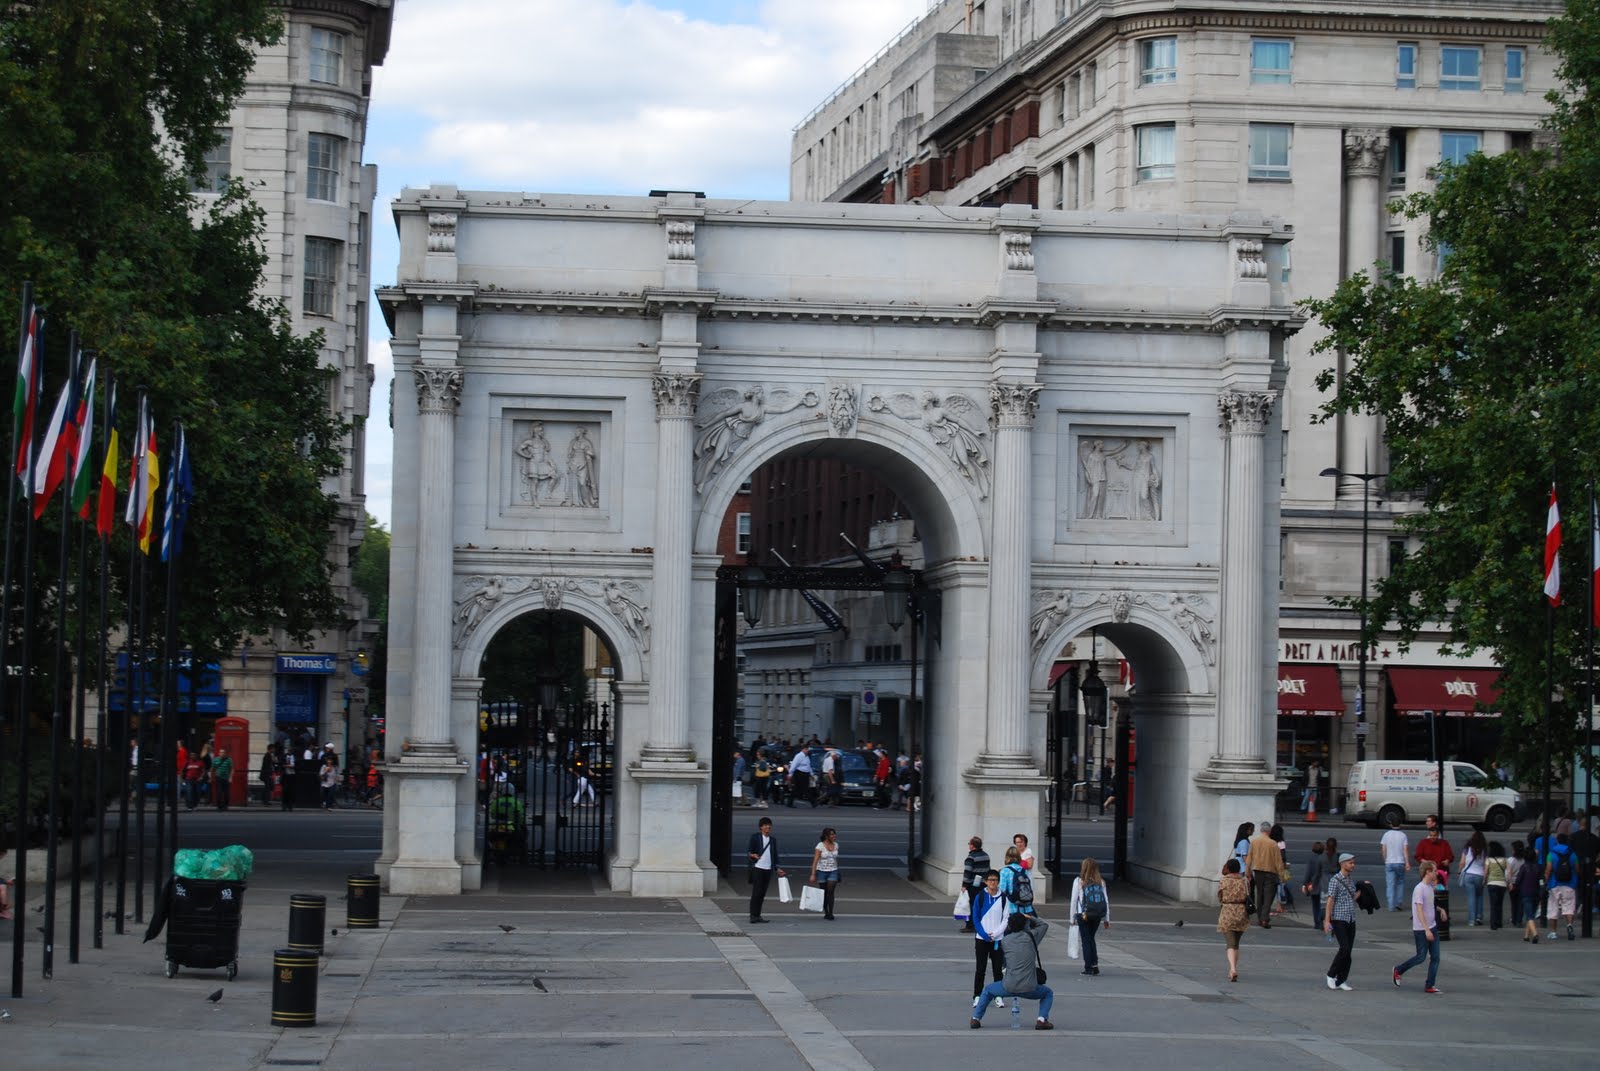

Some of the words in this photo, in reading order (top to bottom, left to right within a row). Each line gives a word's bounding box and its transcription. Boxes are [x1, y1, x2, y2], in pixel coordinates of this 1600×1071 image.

[1285, 643, 1311, 659] PRET
[1317, 644, 1324, 660] A
[282, 657, 323, 669] Thomas
[1445, 681, 1477, 695] PRET
